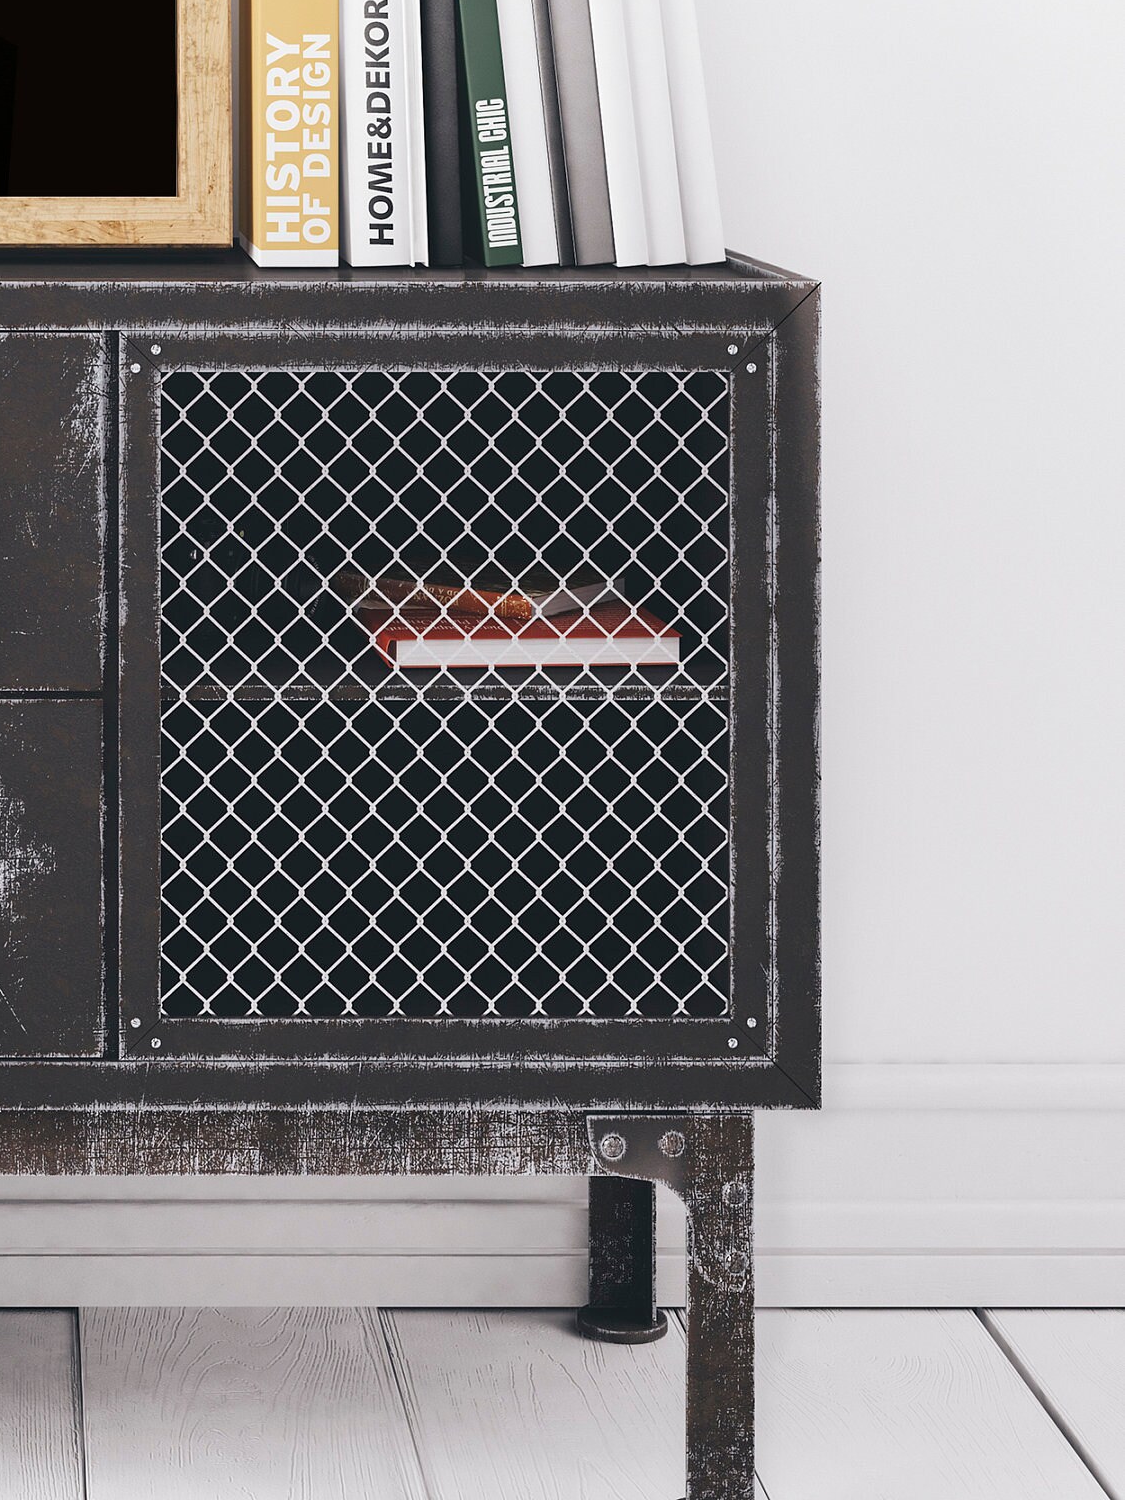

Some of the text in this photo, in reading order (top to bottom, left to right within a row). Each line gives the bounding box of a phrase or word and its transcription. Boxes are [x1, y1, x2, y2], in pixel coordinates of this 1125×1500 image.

[265, 32, 301, 243] HISTORY
[302, 33, 331, 244] OF DESIGN
[475, 98, 519, 249] INDUSTRIAL CHIC
